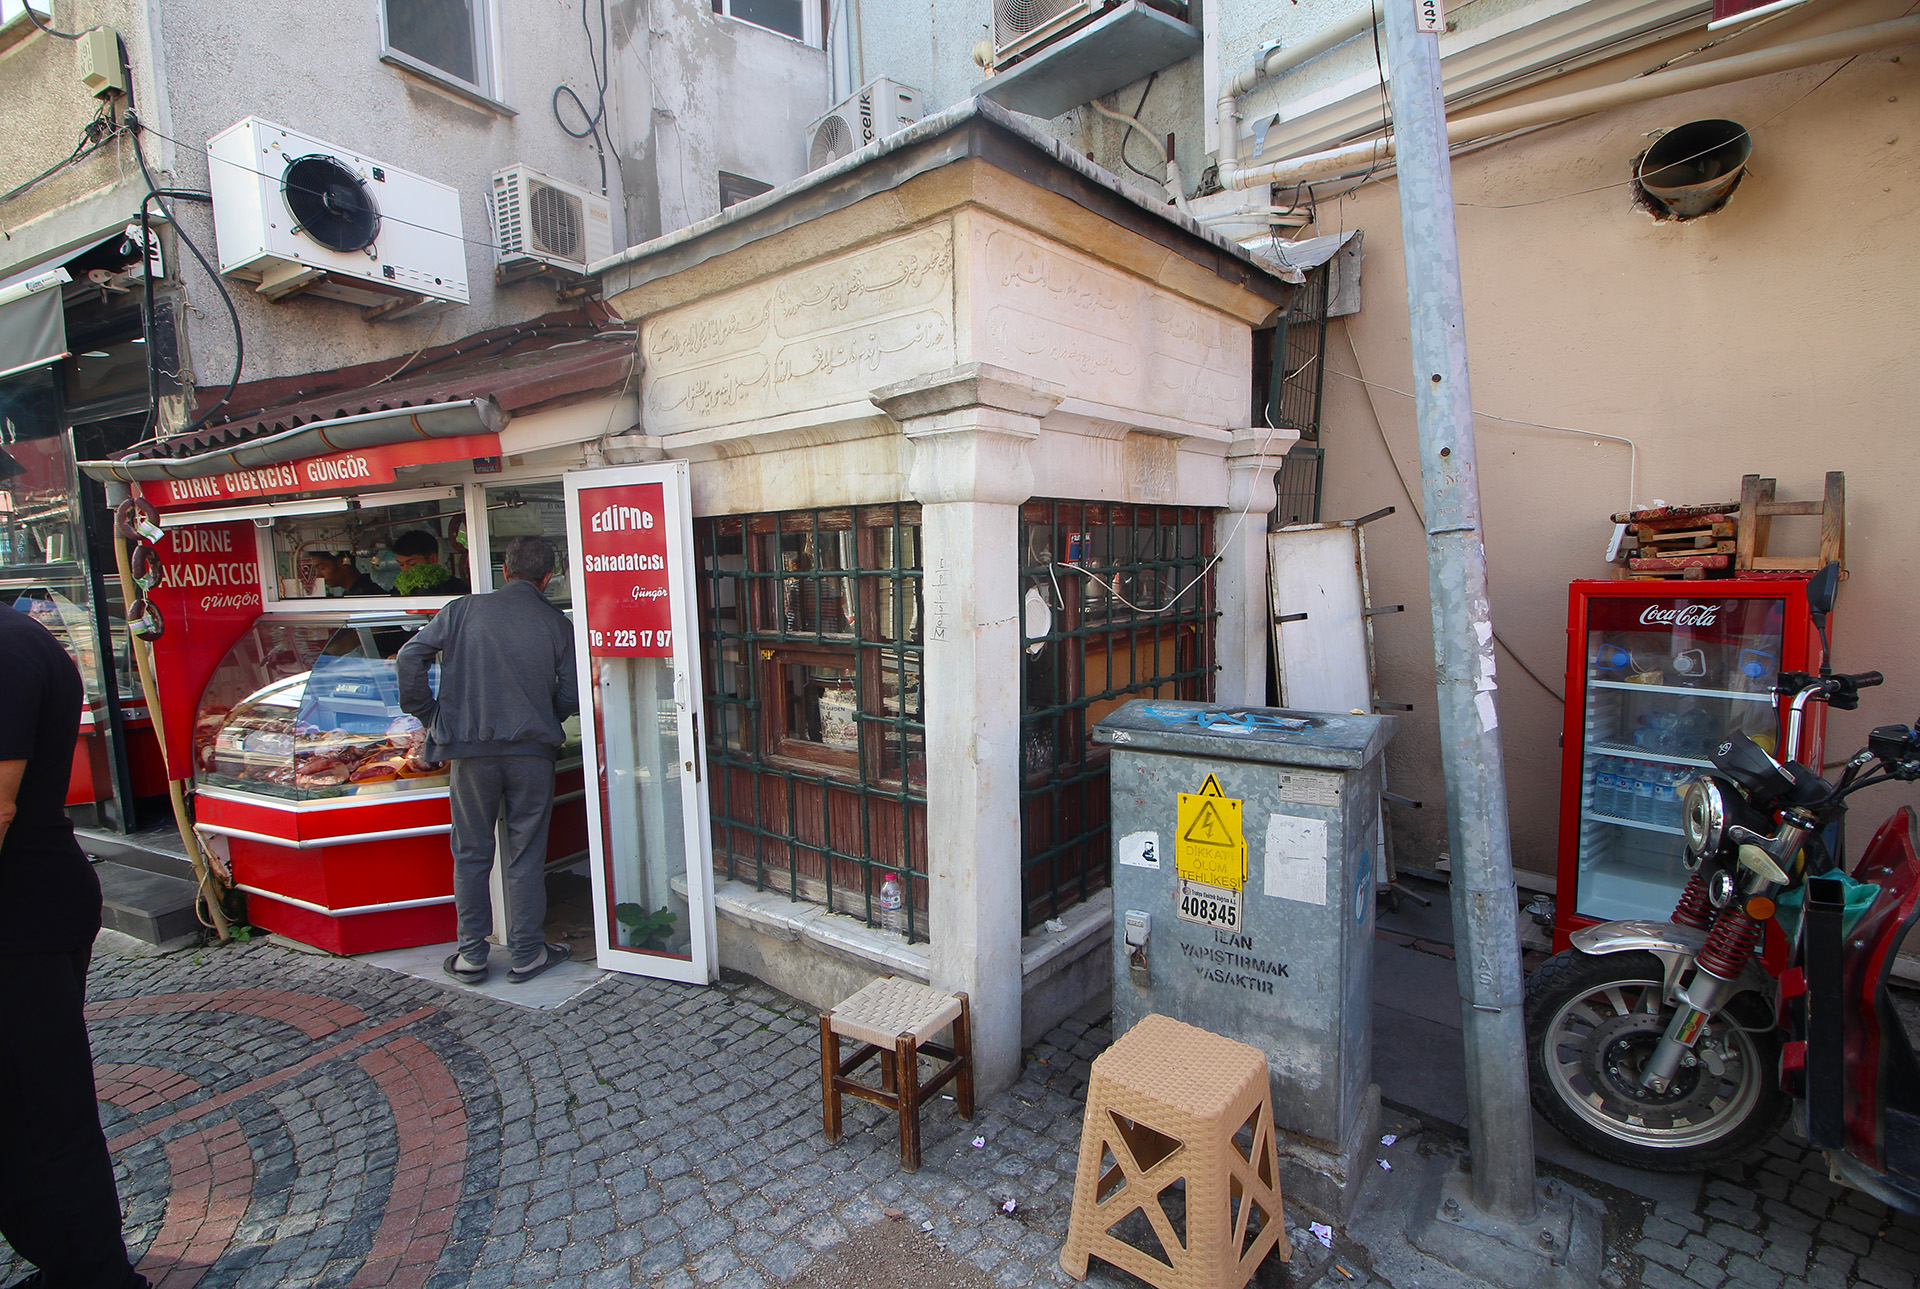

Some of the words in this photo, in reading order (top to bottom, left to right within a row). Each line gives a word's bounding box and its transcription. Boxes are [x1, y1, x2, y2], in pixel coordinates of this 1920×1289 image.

[306, 454, 371, 483] GÜNGÖR
[591, 504, 654, 533] Edirne
[171, 524, 233, 554] EDİRNE
[158, 562, 260, 588] AKADATCISI
[631, 585, 668, 602] Güngör
[1639, 604, 1721, 627] Coca-Cola
[613, 629, 637, 648] 225
[639, 629, 653, 647] 17
[656, 629, 672, 648] 97
[1193, 859, 1227, 874] ÖLÜM
[1181, 895, 1236, 927] 408345
[1180, 942, 1289, 978] YAPIŞTIRMAK
[1195, 966, 1274, 995] YASAKTIR
